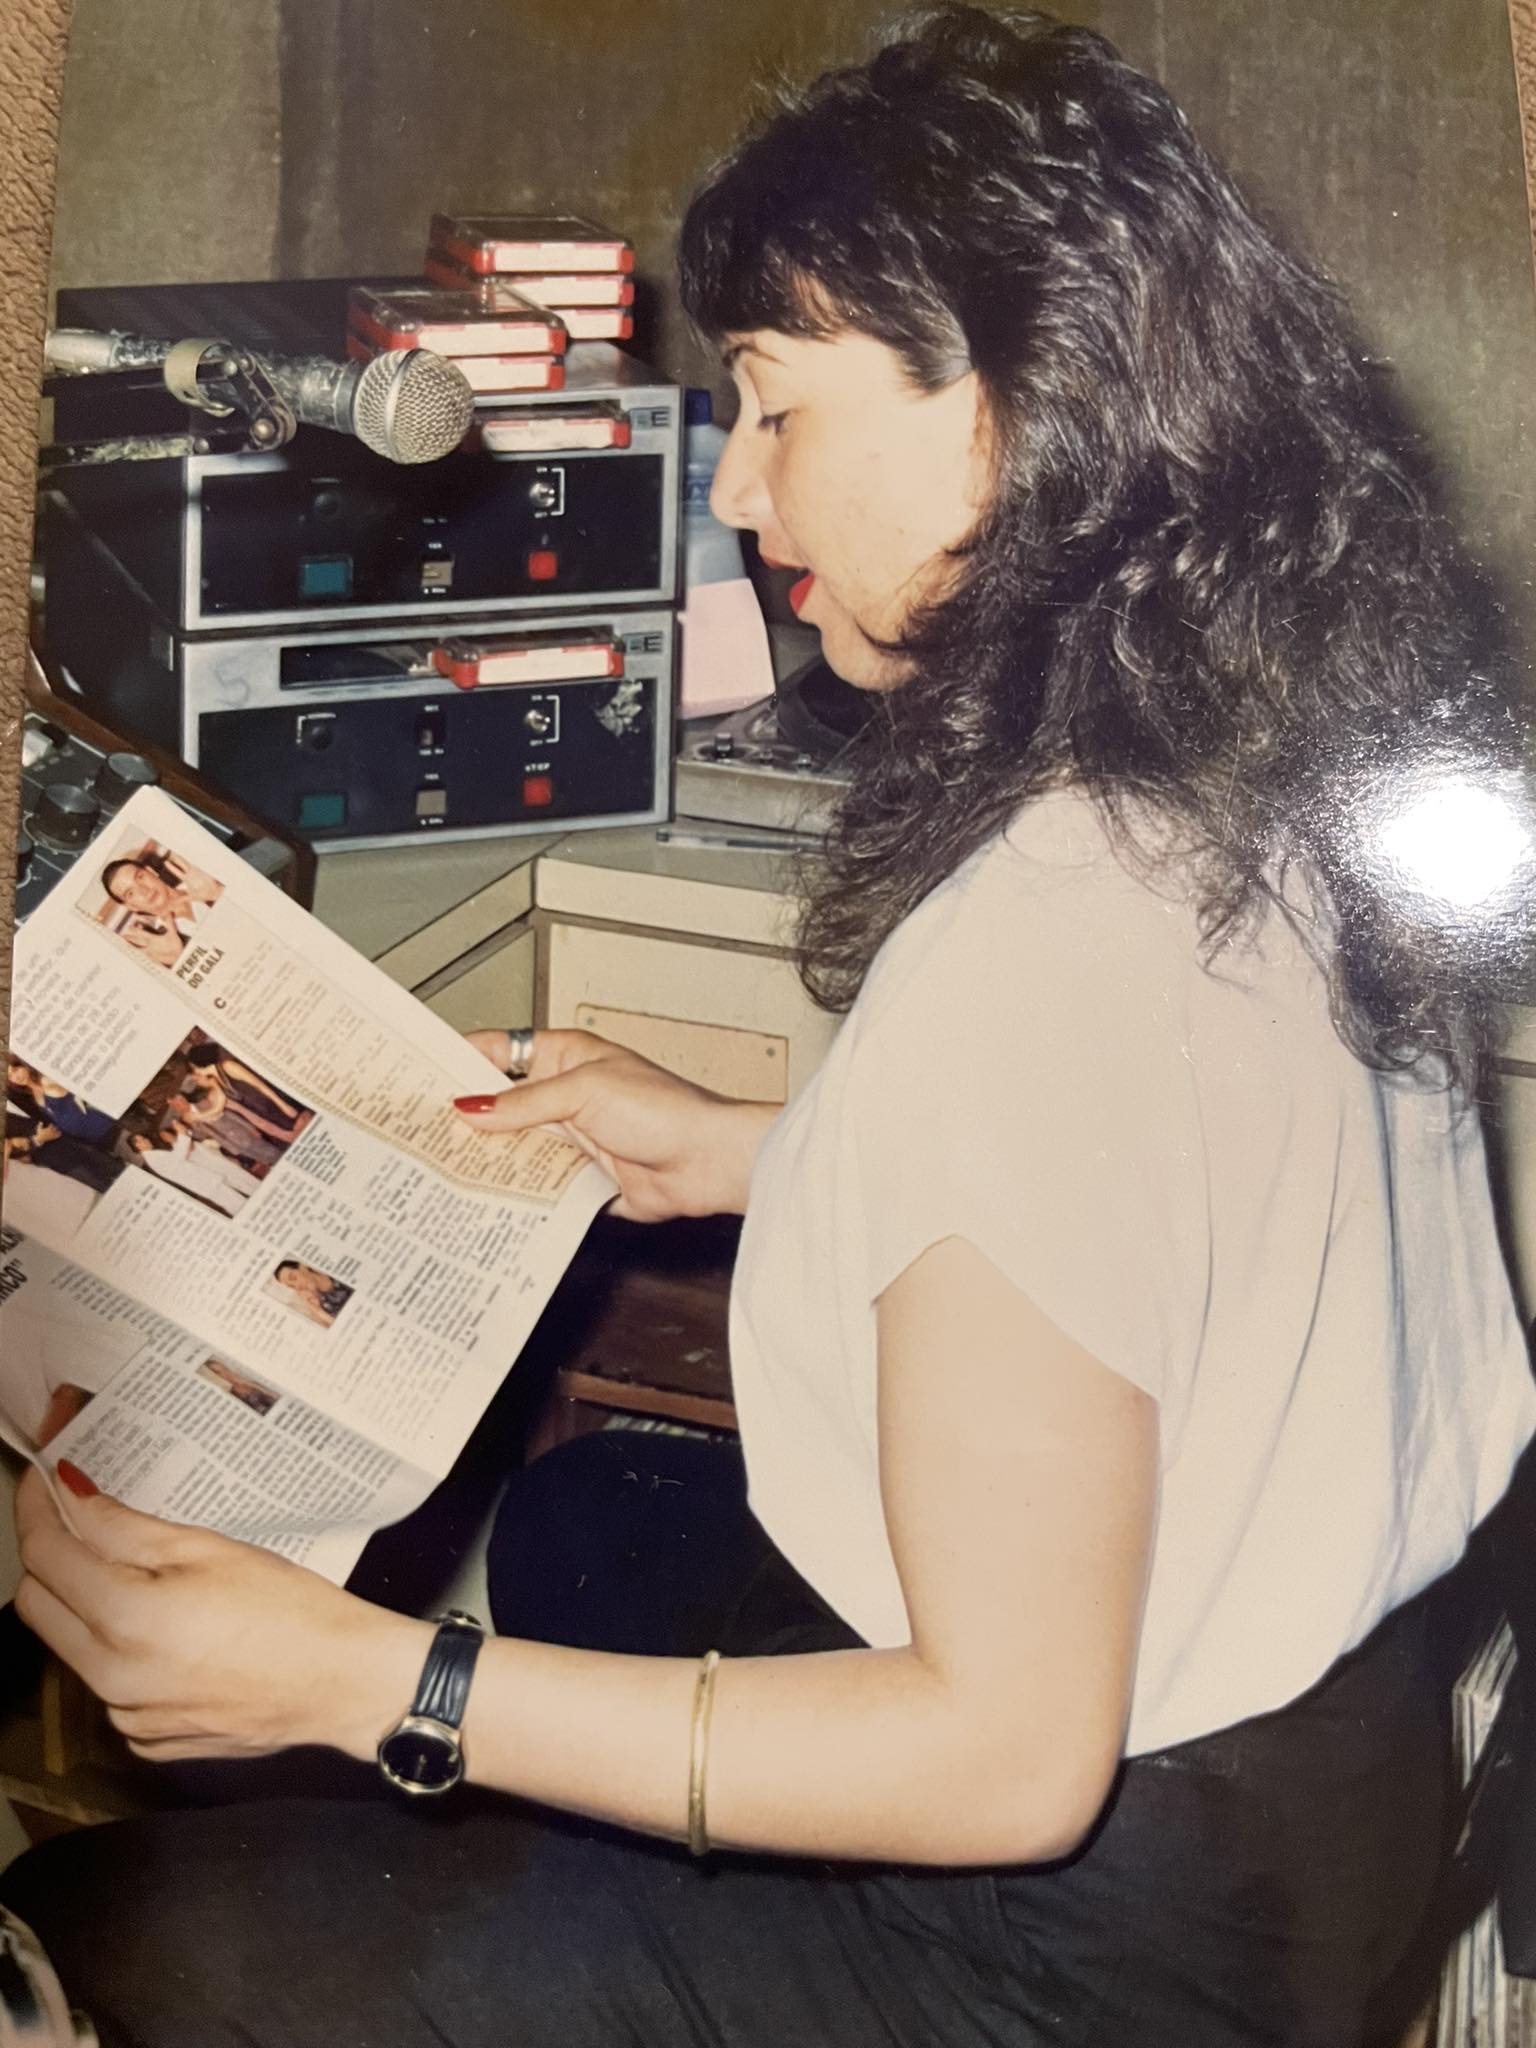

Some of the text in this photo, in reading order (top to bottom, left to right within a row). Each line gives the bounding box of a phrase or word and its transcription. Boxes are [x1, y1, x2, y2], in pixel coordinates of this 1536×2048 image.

[176, 945, 208, 979] PERFIL
[188, 972, 204, 989] DO
[214, 996, 227, 1009] C
